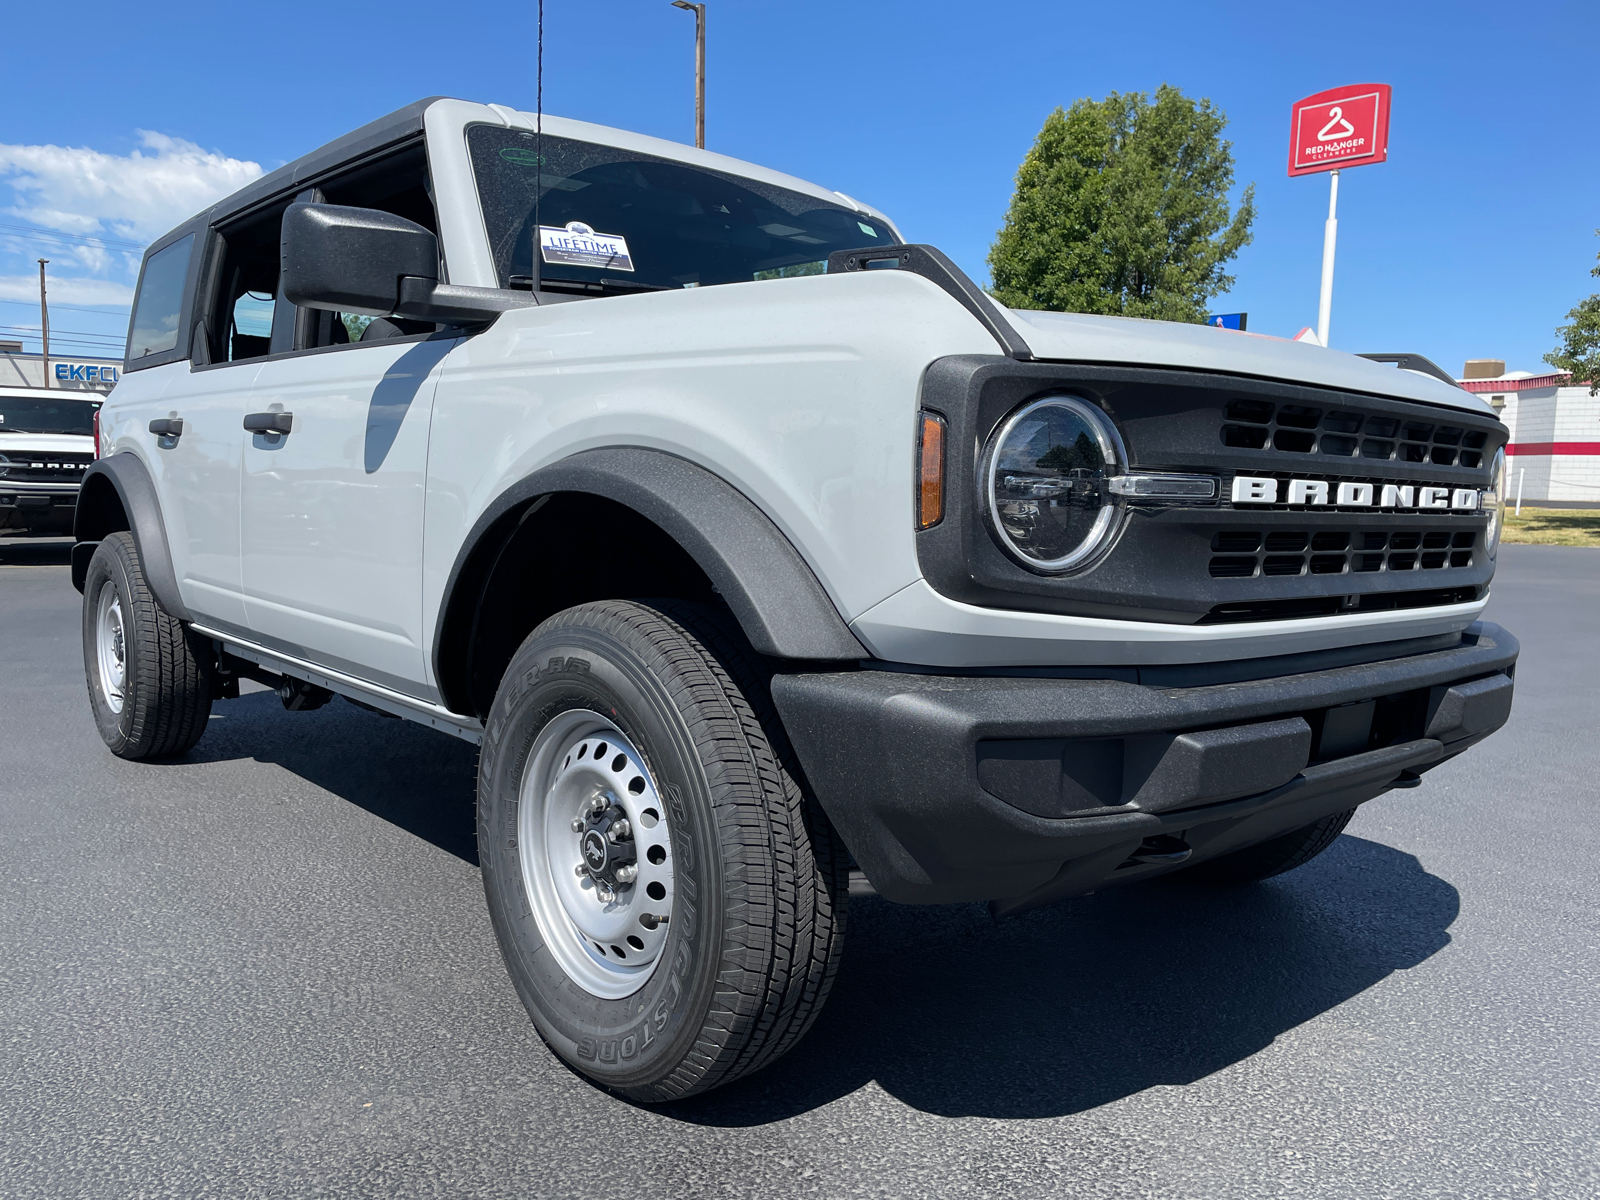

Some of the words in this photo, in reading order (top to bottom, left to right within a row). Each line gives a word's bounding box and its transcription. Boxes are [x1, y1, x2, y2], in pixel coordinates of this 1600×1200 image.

[1305, 146, 1324, 155] RED
[1325, 138, 1364, 151] HANGER
[1312, 147, 1356, 160] CLEANERS
[550, 237, 617, 252] LIFETIME
[1231, 476, 1479, 509] BRONCO
